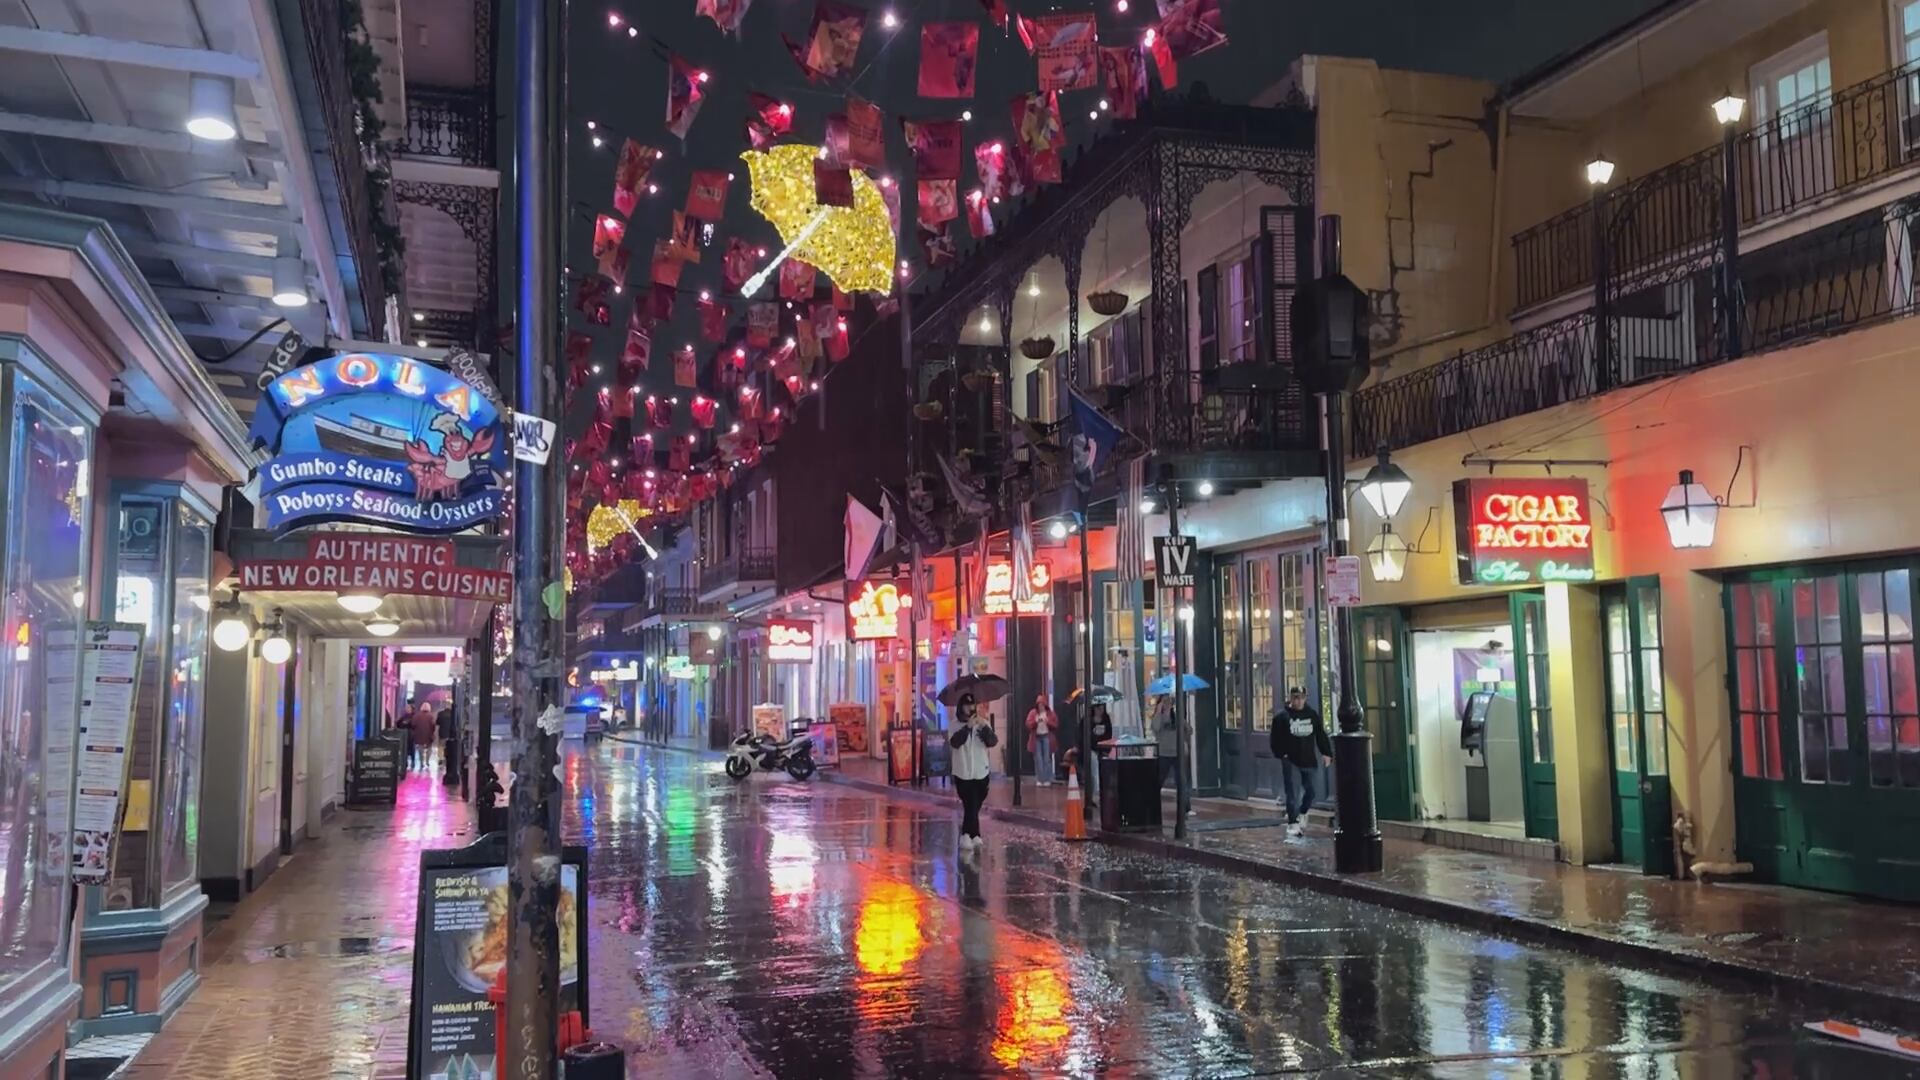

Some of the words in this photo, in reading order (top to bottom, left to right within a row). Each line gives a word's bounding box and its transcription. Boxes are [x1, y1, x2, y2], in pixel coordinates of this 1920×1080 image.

[257, 338, 298, 391] Olde
[281, 356, 473, 421] NOLA
[271, 458, 336, 482] Gumbo
[345, 459, 403, 486] Steaks
[277, 491, 344, 514] Poboys
[351, 490, 422, 519] Seafood
[430, 497, 493, 524] Oysters
[1485, 493, 1582, 522] CIGAR
[1477, 523, 1591, 548] FACTORY
[315, 540, 447, 566] AUTHENTIC
[1162, 545, 1190, 575] IV
[244, 565, 299, 586] NEW
[305, 565, 415, 589] ORLEANS
[421, 570, 510, 597] CUISINE
[1163, 574, 1195, 586] WASTE
